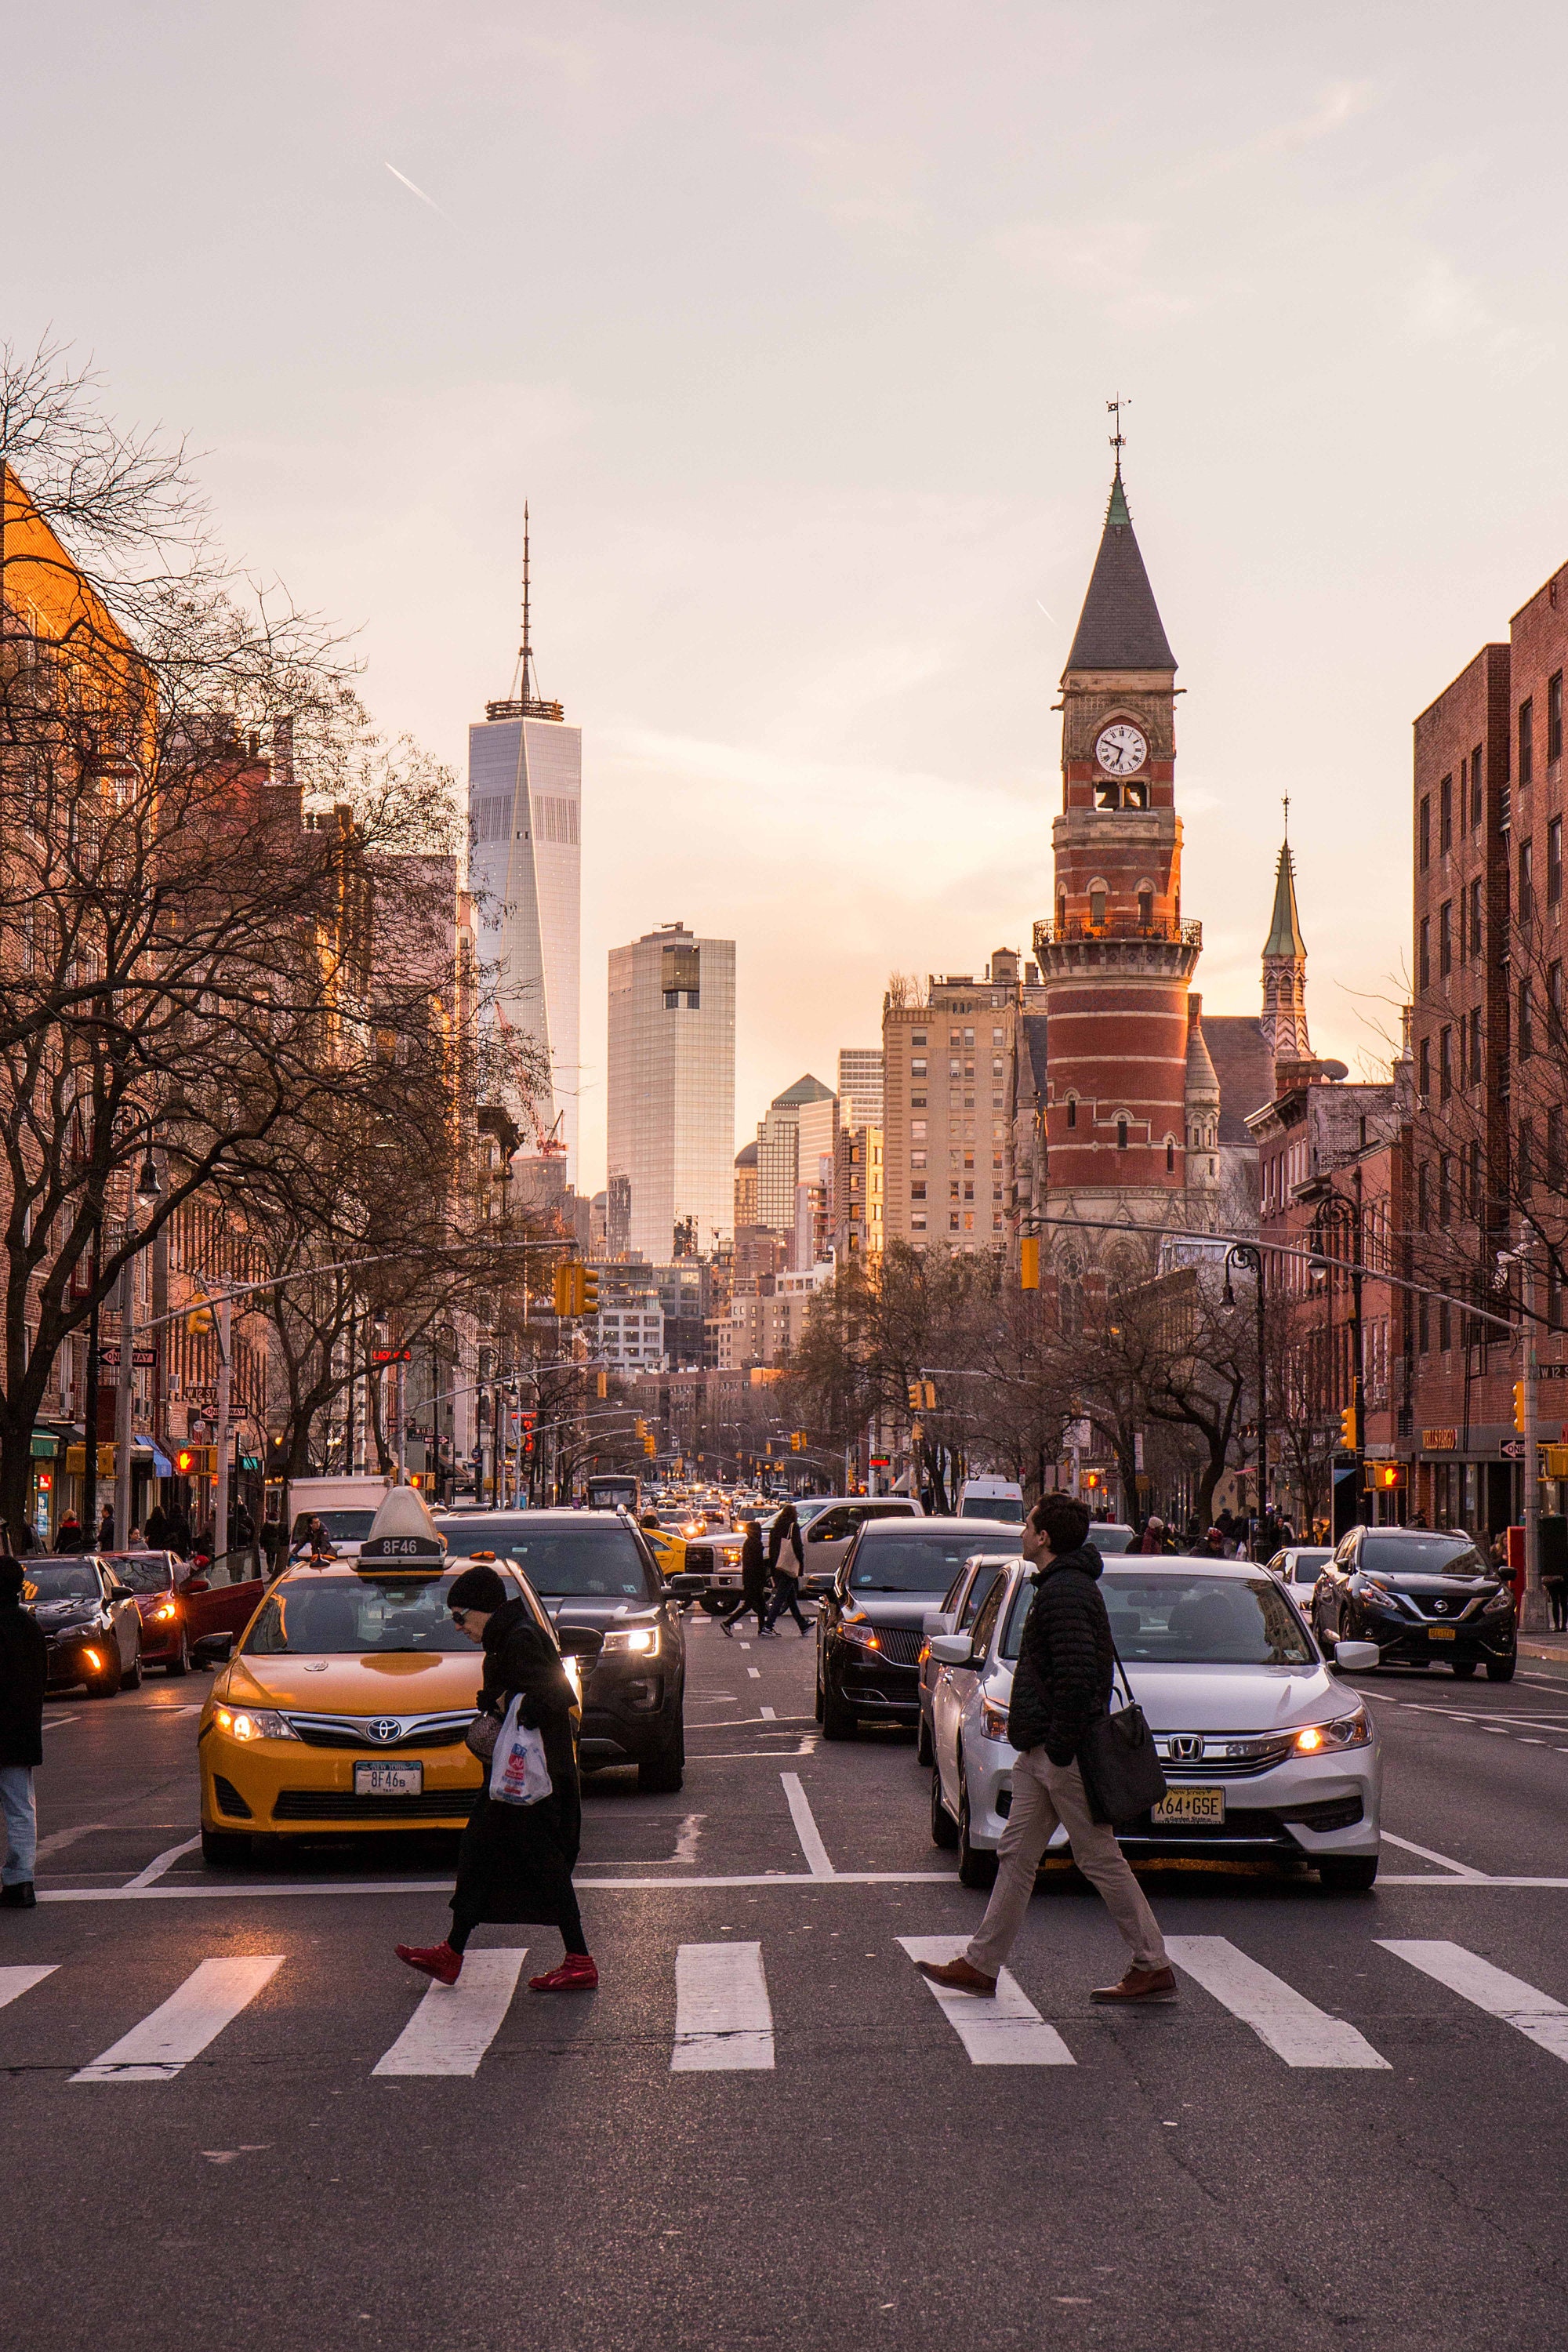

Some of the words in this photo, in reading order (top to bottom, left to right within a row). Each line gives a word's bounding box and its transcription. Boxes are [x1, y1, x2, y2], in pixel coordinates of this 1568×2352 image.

[107, 1352, 121, 1361] ON
[132, 1353, 149, 1362] WAY
[372, 1350, 411, 1361] LIQR
[1541, 1367, 1548, 1378] W
[1552, 1367, 1561, 1378] 12
[187, 1388, 193, 1397] W
[196, 1388, 203, 1398] 12
[205, 1389, 216, 1398] ST
[1422, 1430, 1438, 1449] WELLS
[1438, 1429, 1456, 1449] FARGO
[383, 1540, 417, 1554] 8F46
[372, 1772, 405, 1787] 8F46B
[1192, 1798, 1219, 1815] GSE
